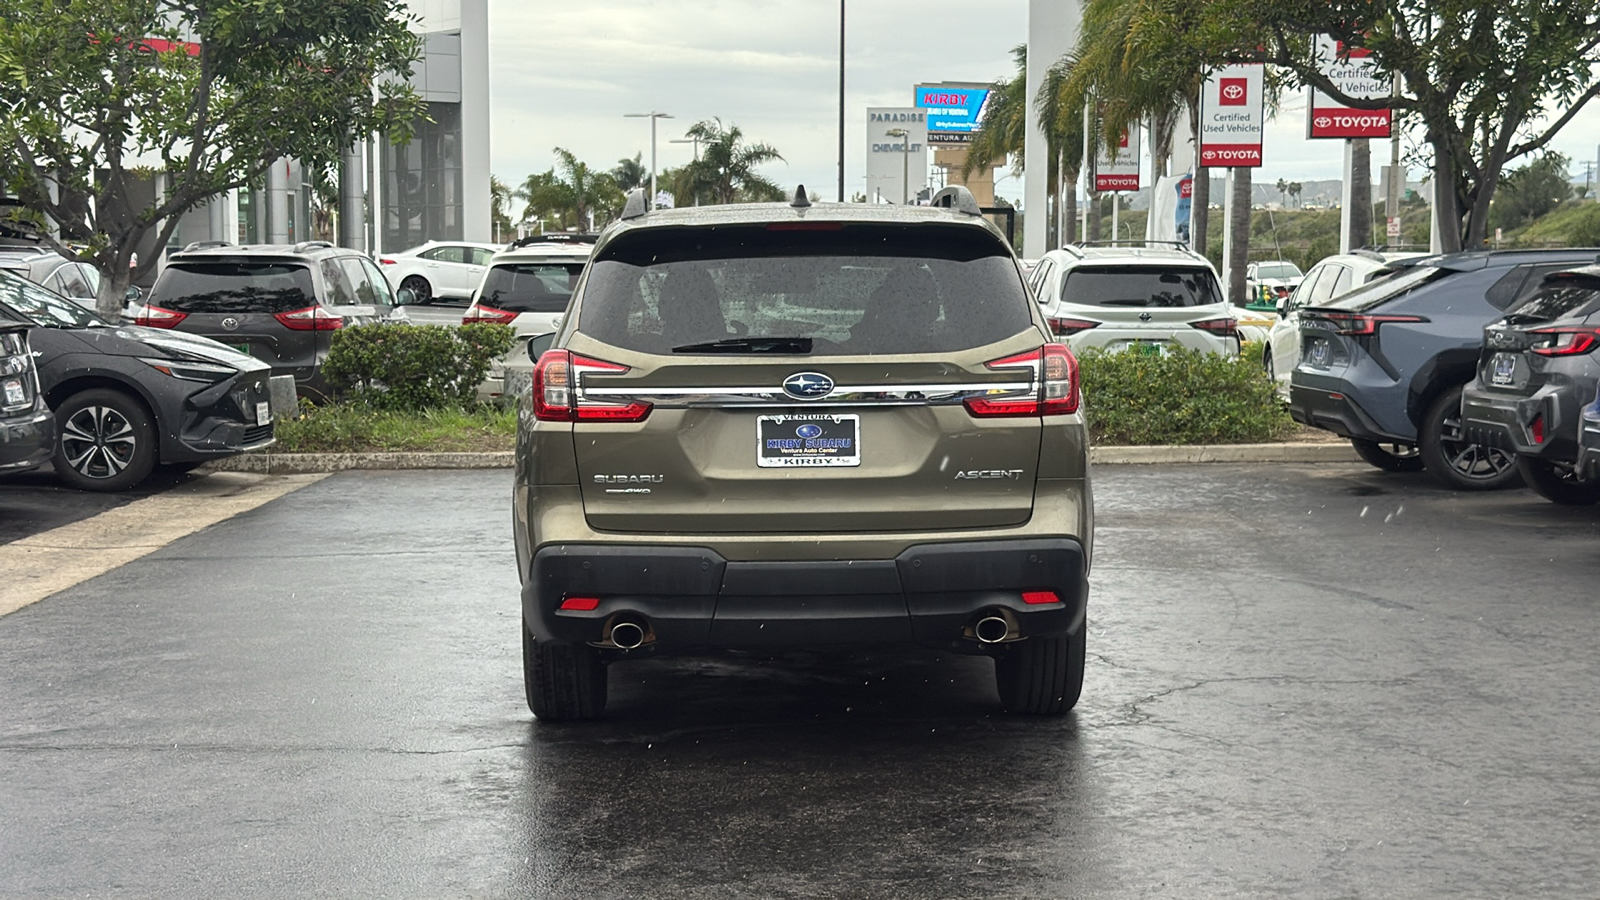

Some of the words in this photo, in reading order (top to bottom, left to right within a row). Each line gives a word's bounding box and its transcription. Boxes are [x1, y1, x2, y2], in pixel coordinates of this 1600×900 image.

[1346, 82, 1390, 92] Vehicles
[924, 93, 968, 106] KIRBY
[871, 113, 924, 122] PARADISE
[1213, 113, 1251, 121] Certified
[1333, 116, 1388, 128] TOYOTA
[1203, 124, 1224, 132] Used
[1226, 124, 1260, 132] Vehicles
[1217, 150, 1260, 159] TOYOTA
[767, 439, 802, 448] KIRBY
[805, 438, 851, 448] SUBARU
[593, 474, 664, 484] SUBARU
[954, 469, 1024, 480] ASCENT
